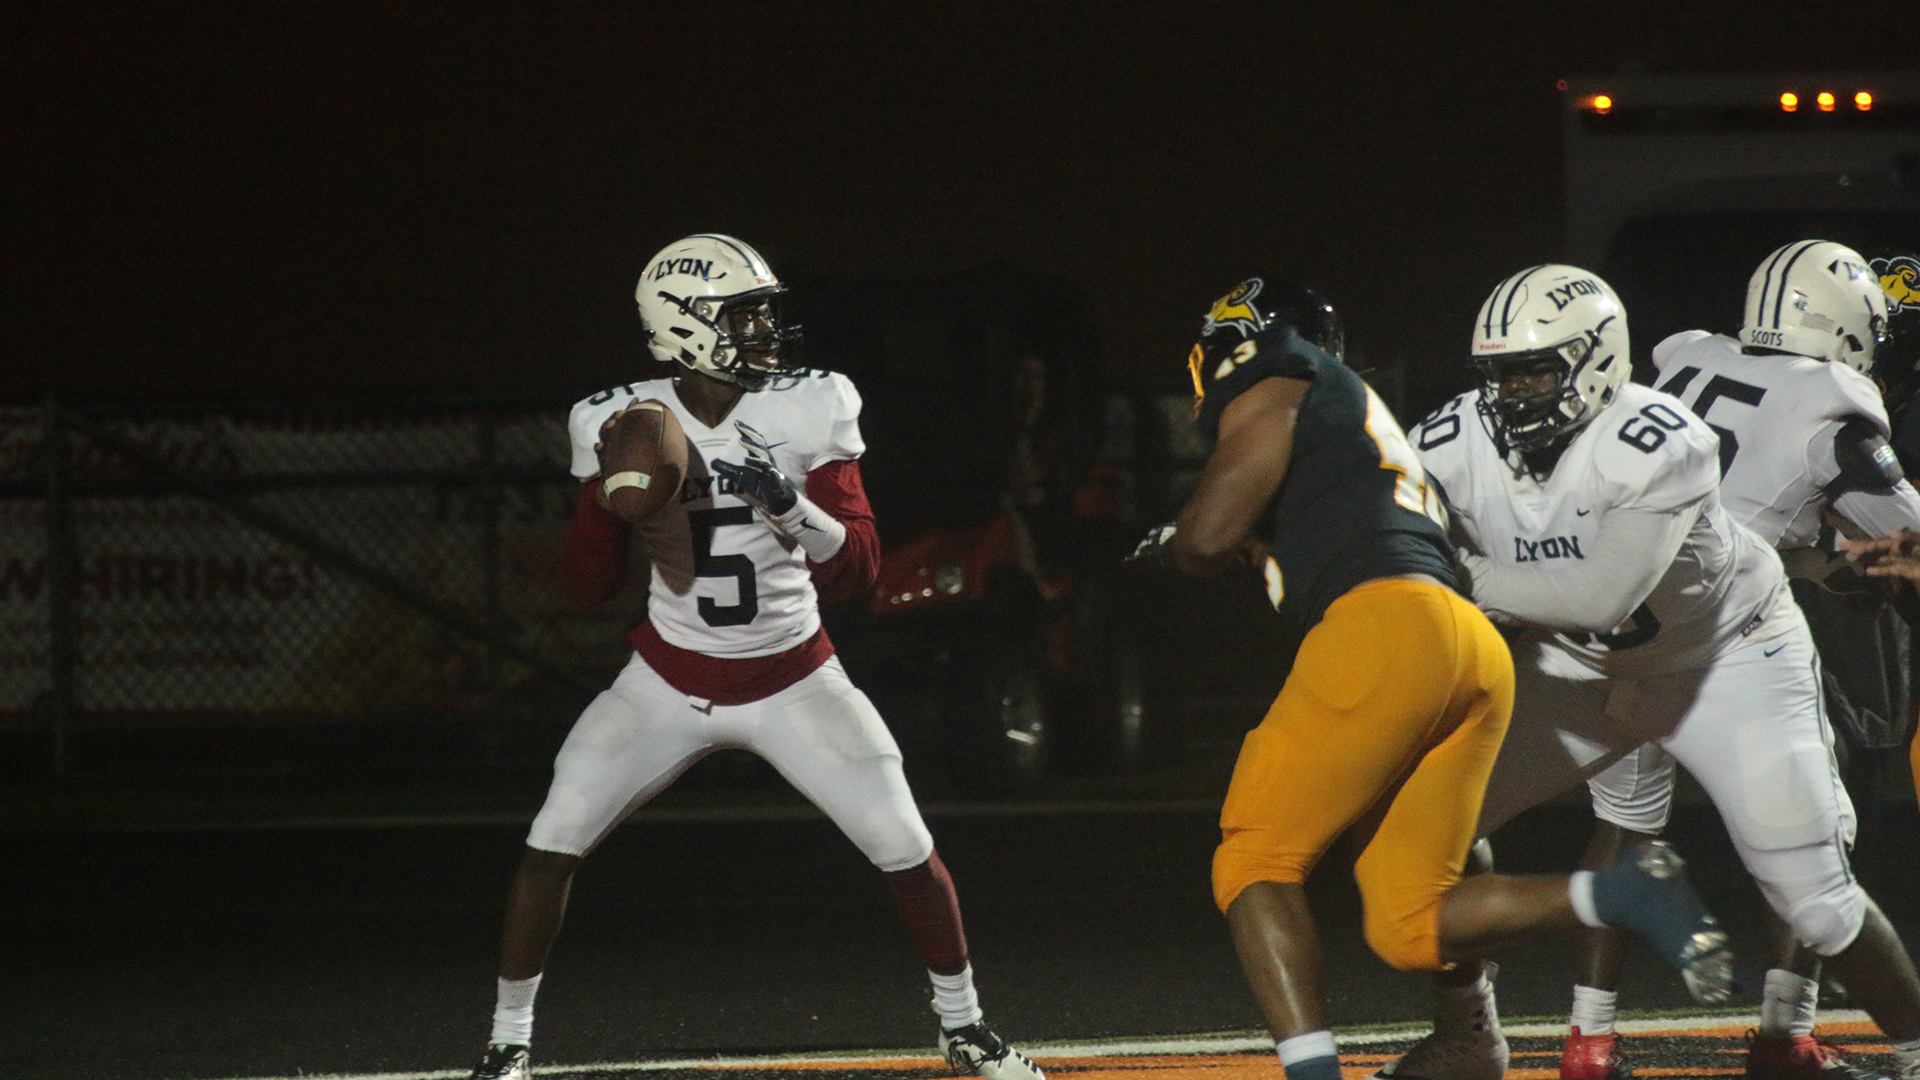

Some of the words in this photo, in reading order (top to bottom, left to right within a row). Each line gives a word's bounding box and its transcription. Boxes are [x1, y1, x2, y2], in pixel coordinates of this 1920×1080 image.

[655, 257, 714, 282] LYON
[1544, 279, 1603, 312] LYON
[1751, 329, 1784, 347] SCOTS
[1617, 403, 1689, 455] 60
[1514, 535, 1585, 563] LYON
[687, 504, 759, 628] 5
